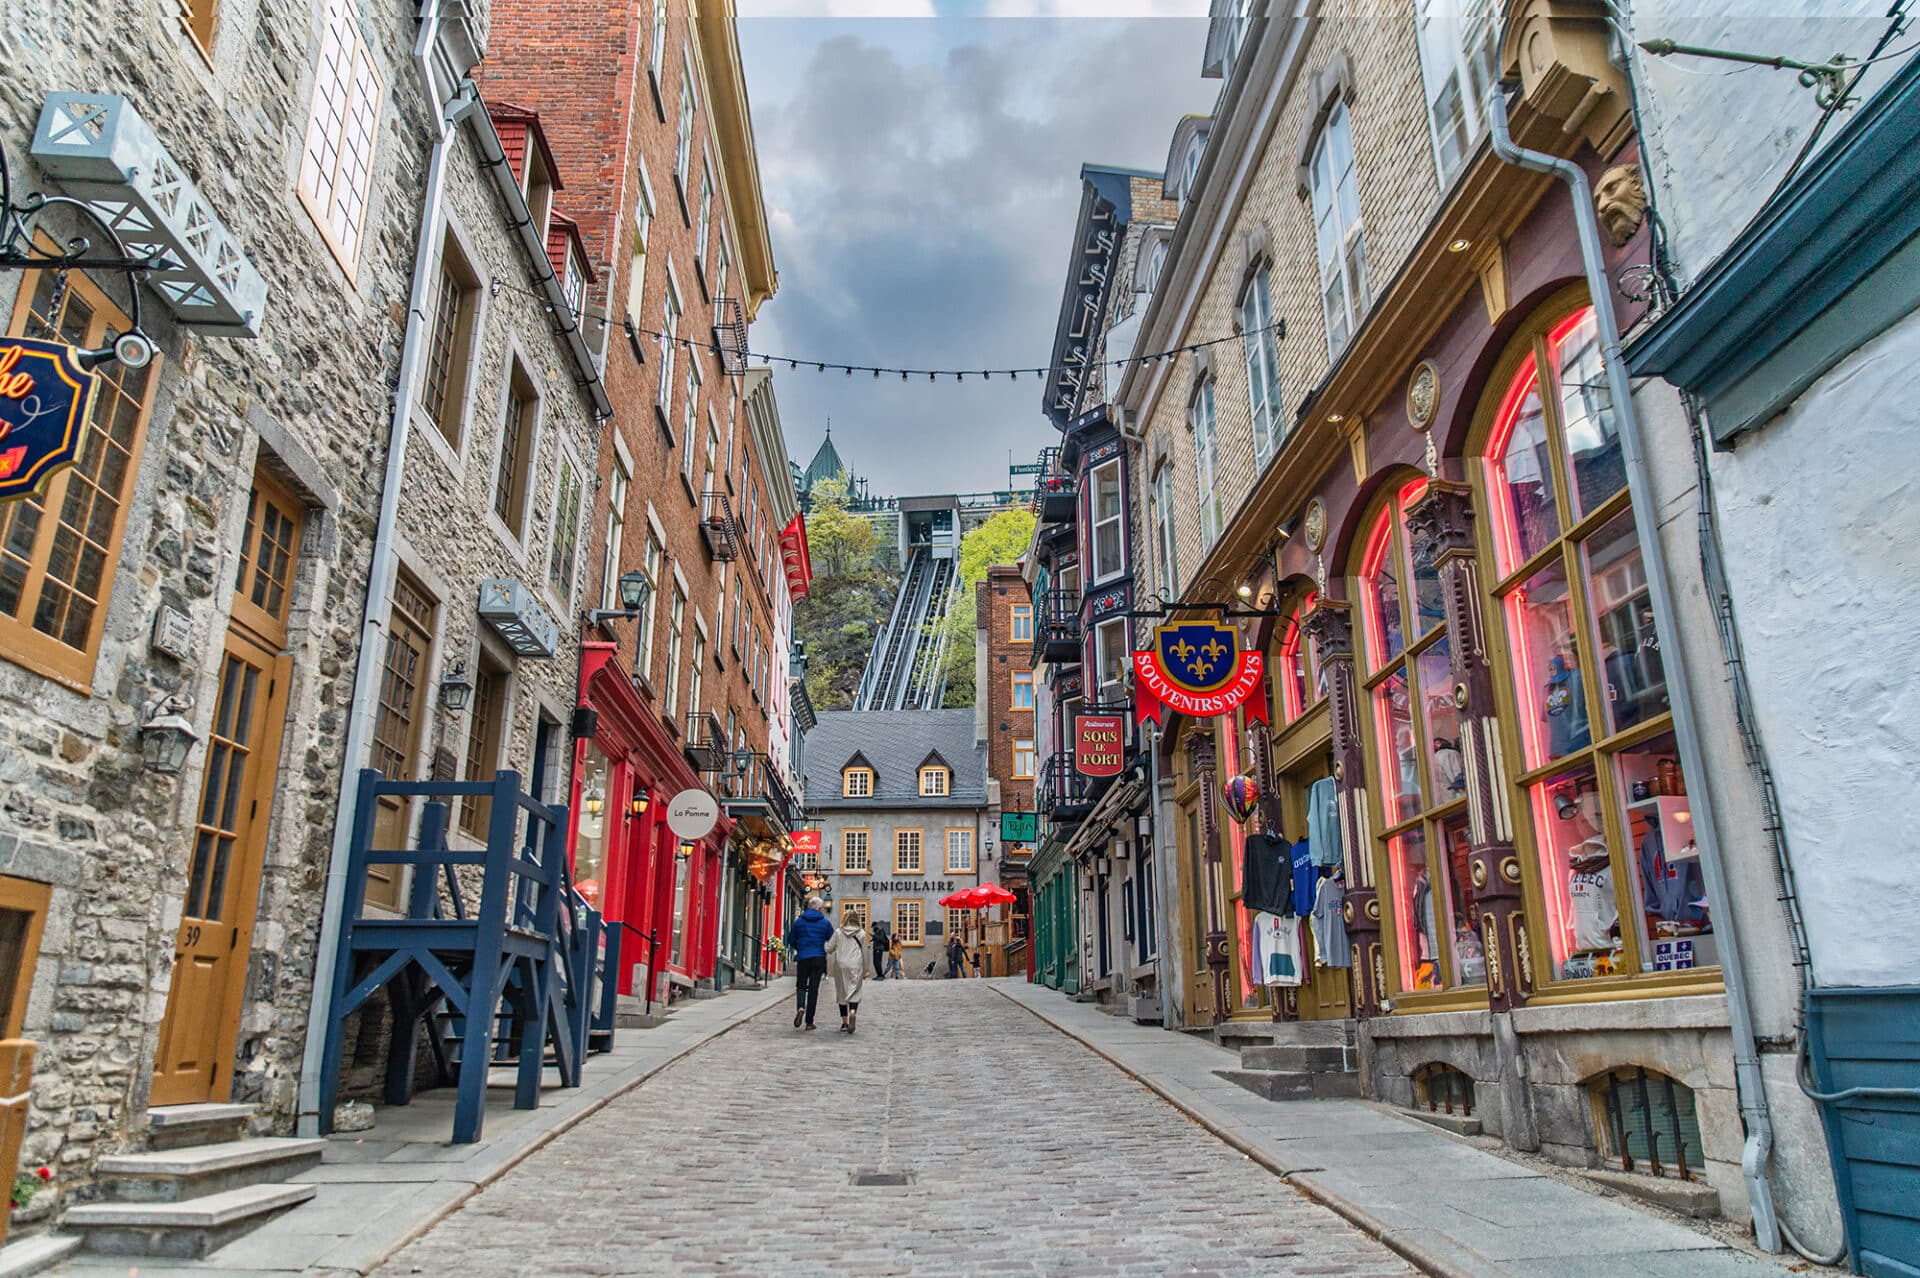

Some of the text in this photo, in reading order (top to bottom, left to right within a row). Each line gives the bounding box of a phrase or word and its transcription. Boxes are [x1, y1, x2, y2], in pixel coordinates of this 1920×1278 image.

[1137, 655, 1260, 712] SOUVENIRS DU LYS
[1082, 730, 1117, 742] SOUS
[1095, 743, 1106, 752] LE
[1081, 753, 1120, 766] FORT
[684, 809, 710, 817] Pomme
[863, 880, 955, 892] FUNICULAIRE
[184, 925, 201, 947] 39
